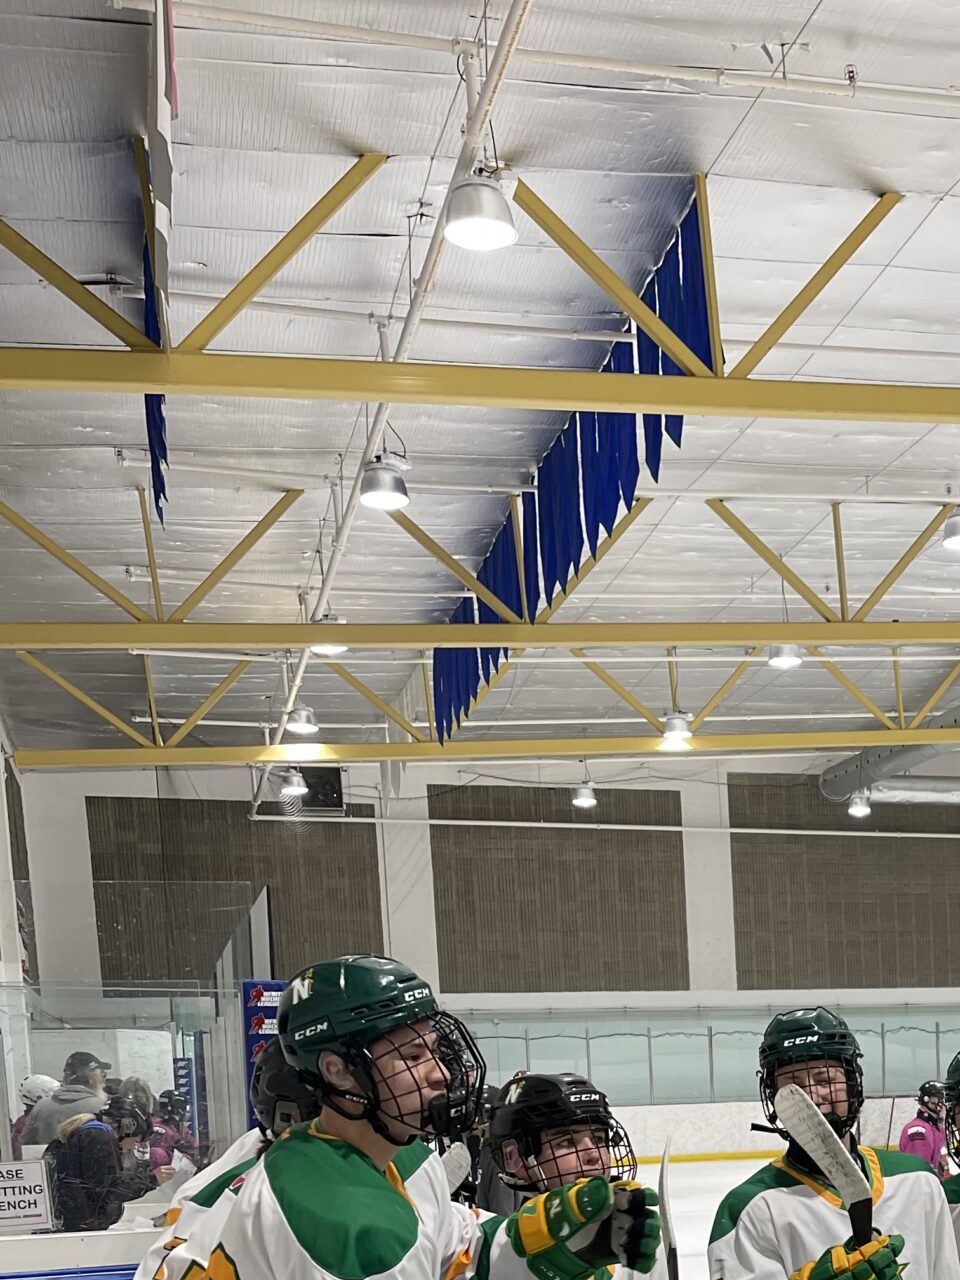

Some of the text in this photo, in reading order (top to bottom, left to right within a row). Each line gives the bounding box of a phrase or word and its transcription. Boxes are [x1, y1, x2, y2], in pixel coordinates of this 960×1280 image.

[291, 976, 313, 1005] N
[404, 987, 430, 1002] CCM
[294, 1021, 329, 1041] CCM
[783, 1034, 819, 1047] CCM
[569, 1094, 600, 1102] CCM
